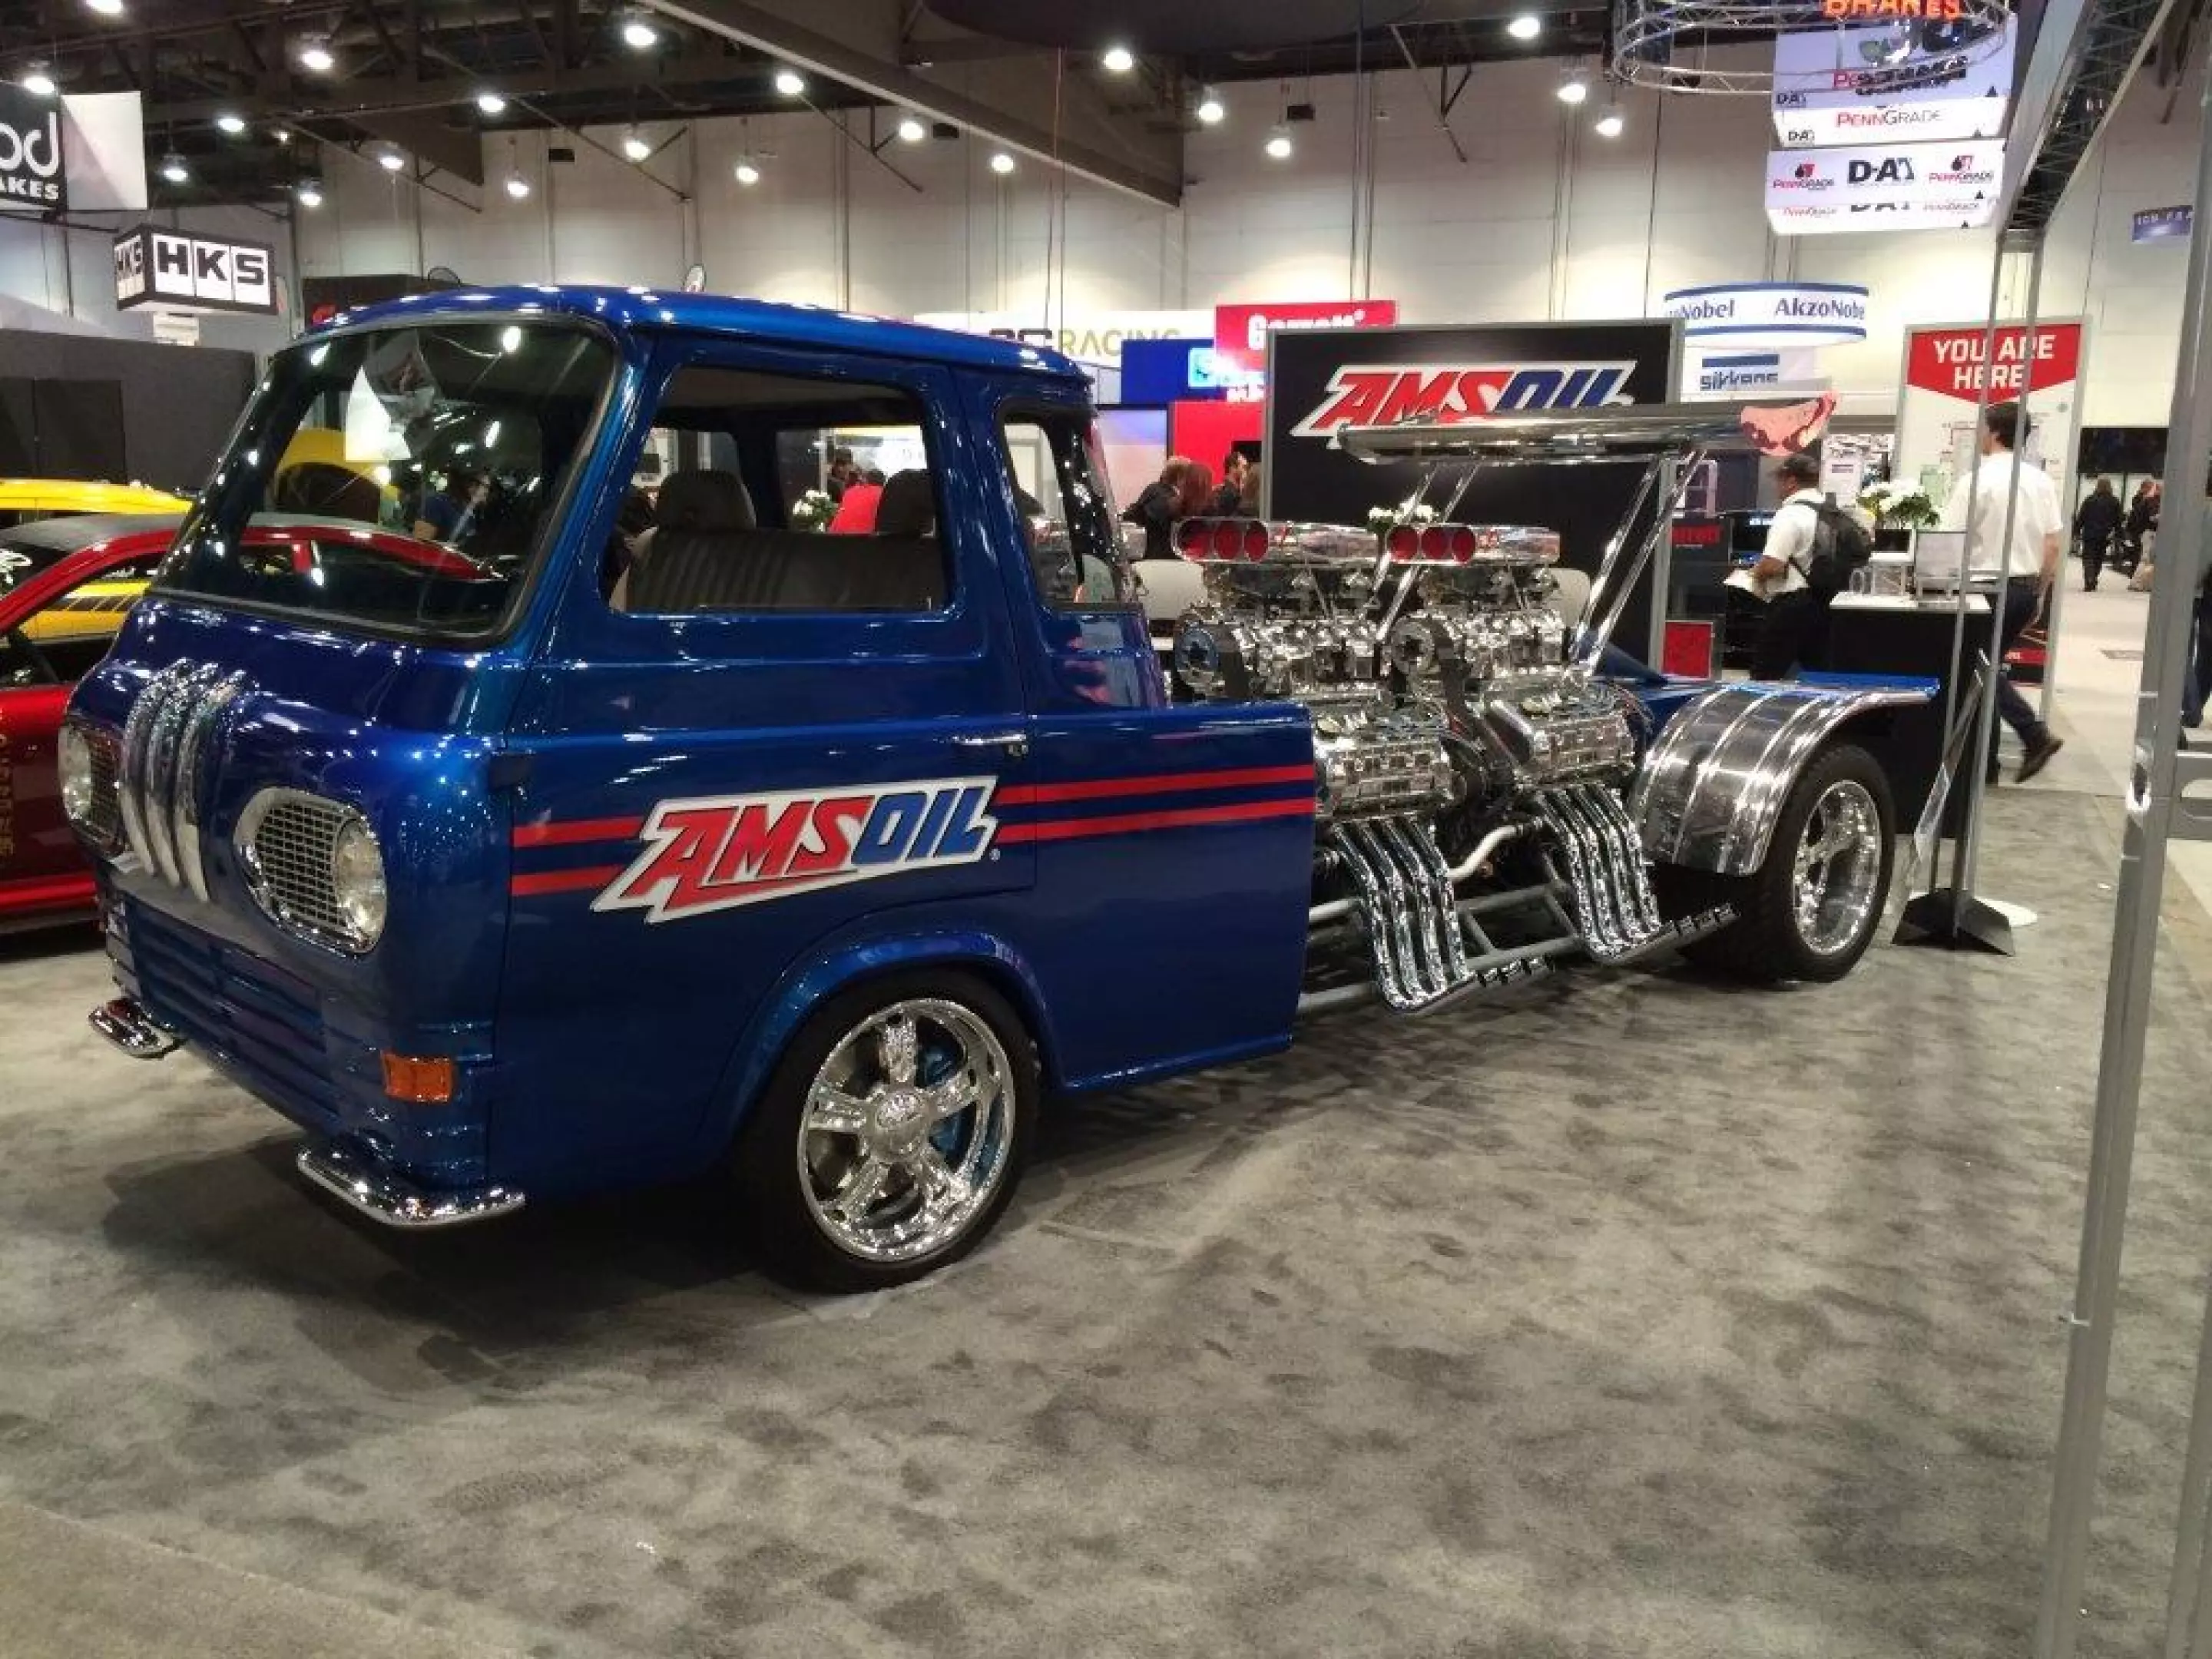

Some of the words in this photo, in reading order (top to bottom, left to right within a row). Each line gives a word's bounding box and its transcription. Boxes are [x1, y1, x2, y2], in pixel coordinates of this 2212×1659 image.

[0, 175, 59, 200] KES
[156, 240, 266, 286] HKS
[1933, 338, 1988, 363] YOU
[1954, 364, 2025, 389] HERE
[603, 780, 994, 919] AMSOIL
